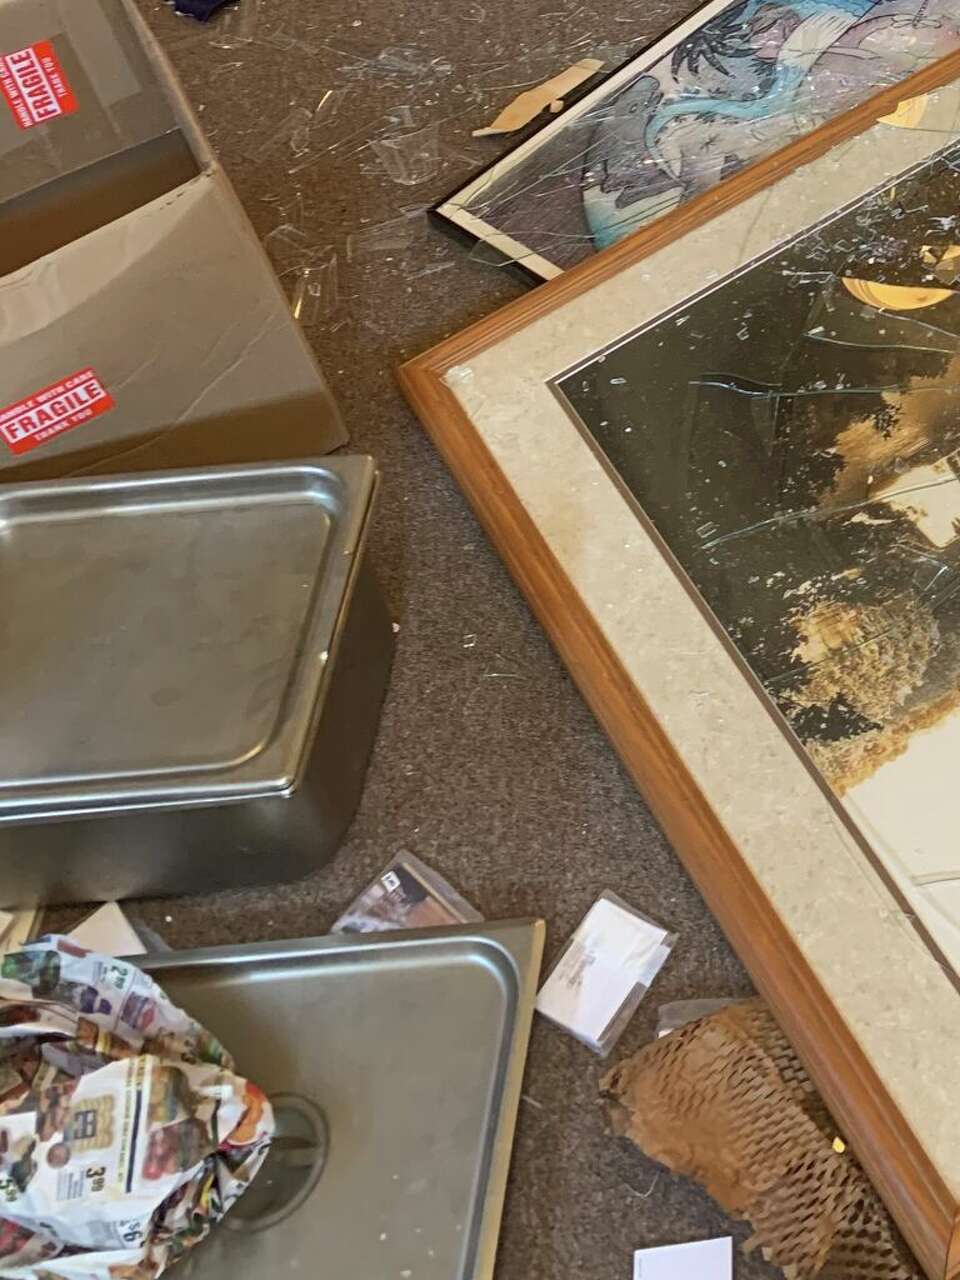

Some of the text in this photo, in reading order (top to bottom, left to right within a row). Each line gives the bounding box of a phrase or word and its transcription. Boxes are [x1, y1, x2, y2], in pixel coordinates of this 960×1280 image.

[9, 49, 58, 119] FRAGILE
[41, 56, 69, 98] THANK YOU
[5, 382, 102, 440] FRAGILE
[34, 407, 93, 441] THANK YOU
